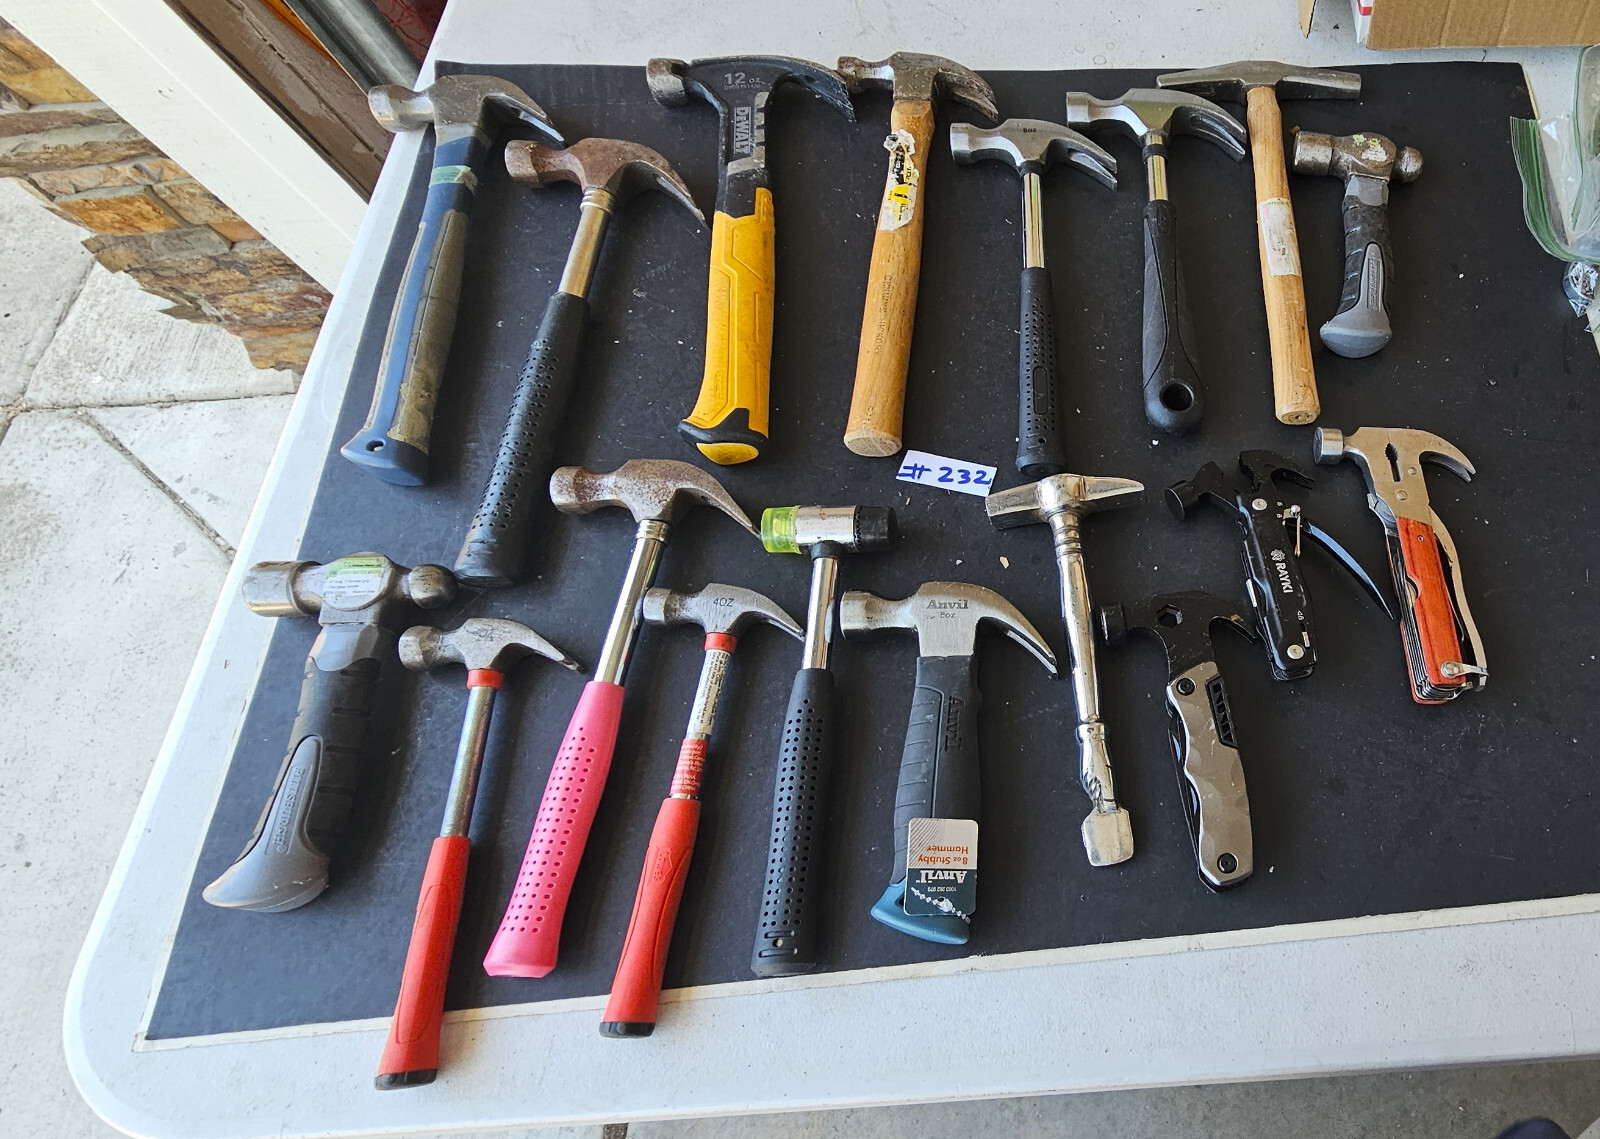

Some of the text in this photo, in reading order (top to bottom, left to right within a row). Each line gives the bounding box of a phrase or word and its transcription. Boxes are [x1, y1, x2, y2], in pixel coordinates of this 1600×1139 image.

[724, 71, 746, 85] 12
[1275, 562, 1294, 594] RAYKI
[926, 599, 969, 610] Anvil
[273, 767, 304, 845] PITTSBURGH
[927, 845, 969, 855] Hammer
[918, 854, 951, 865] Stubby
[920, 869, 968, 884] Anvil
